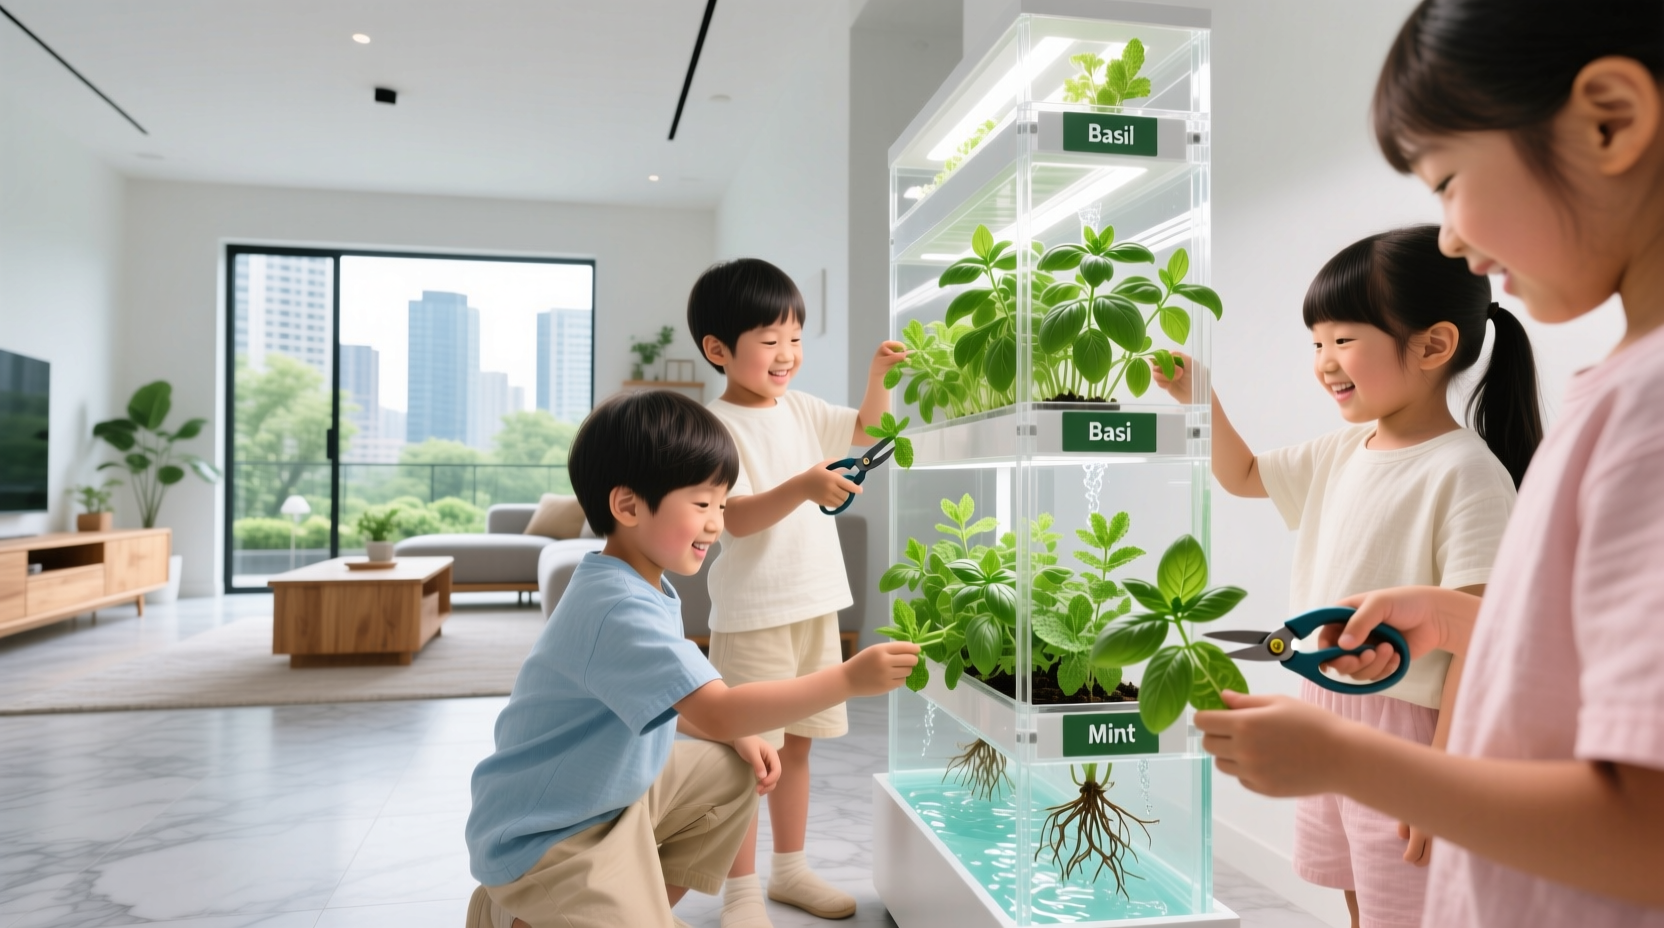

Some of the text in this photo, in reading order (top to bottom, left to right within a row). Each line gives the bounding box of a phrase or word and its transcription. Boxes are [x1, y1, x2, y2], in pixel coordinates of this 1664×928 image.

[1088, 123, 1134, 145] Basil
[1089, 421, 1131, 442] Basi
[1088, 723, 1136, 744] Mint
